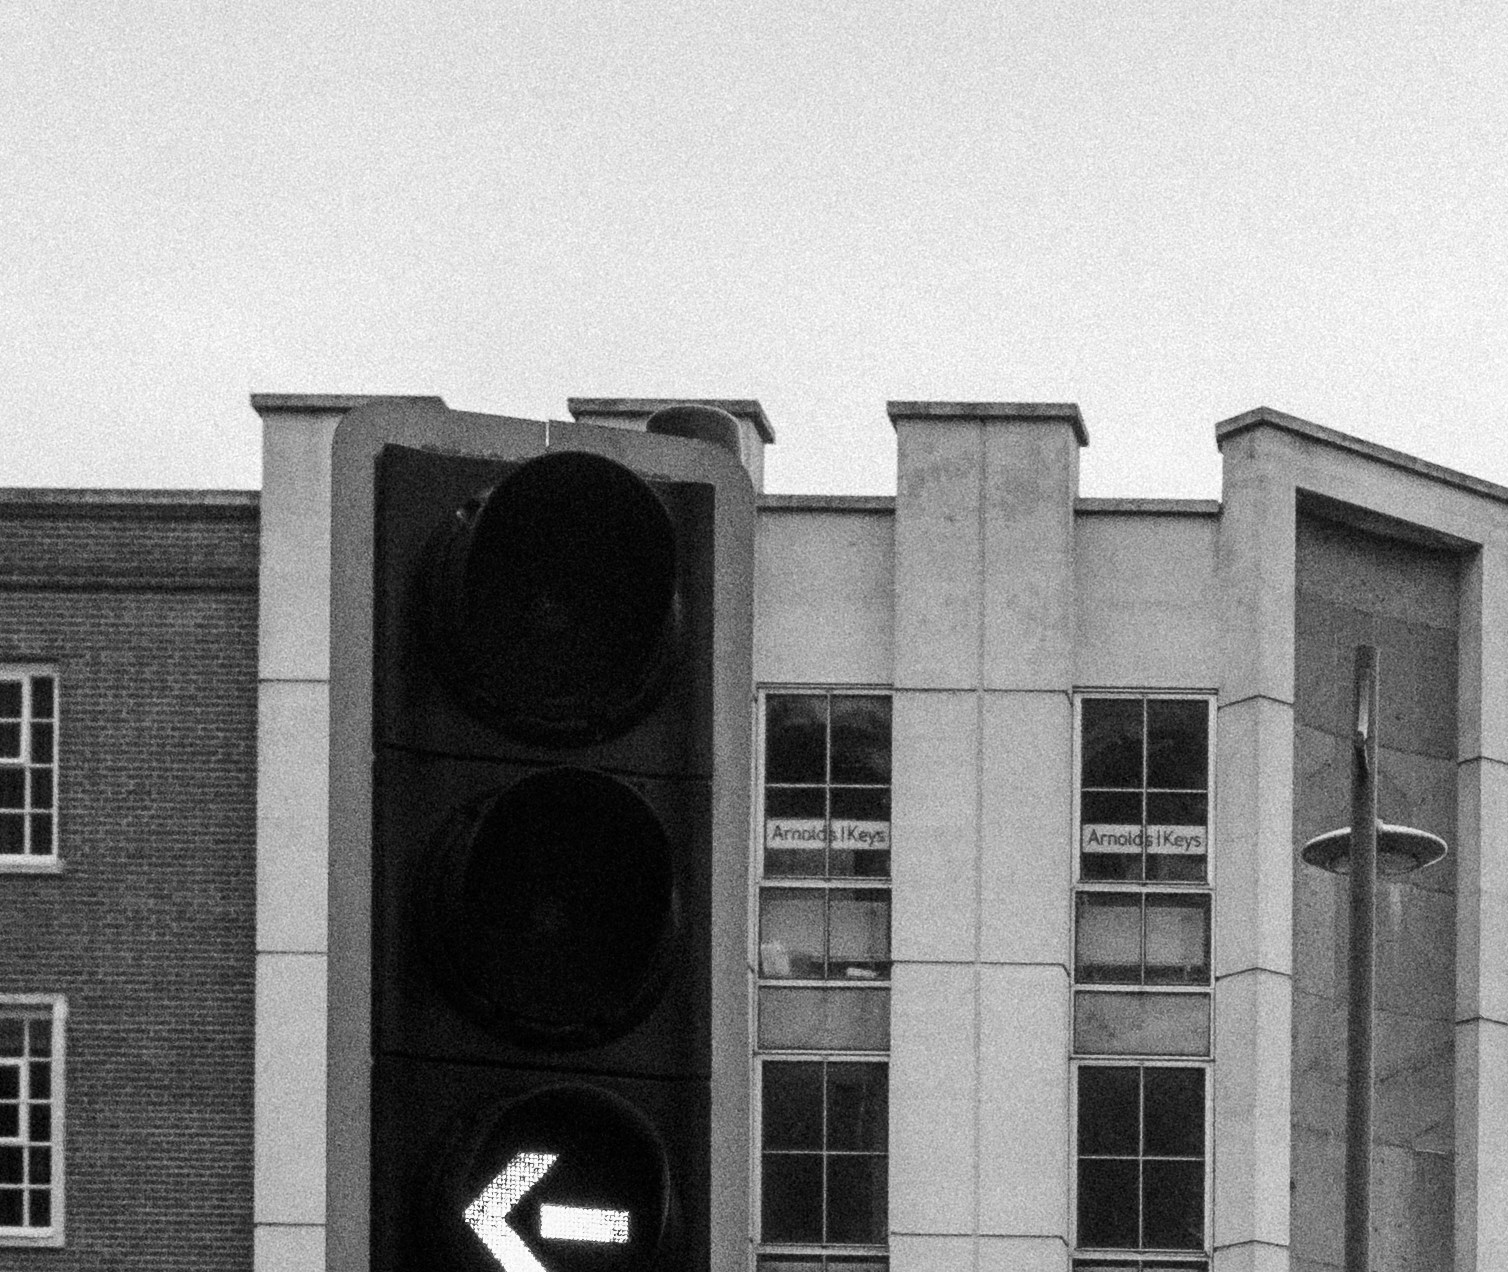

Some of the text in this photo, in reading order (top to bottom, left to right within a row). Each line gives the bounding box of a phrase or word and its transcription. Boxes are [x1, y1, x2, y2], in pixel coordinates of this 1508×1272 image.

[772, 825, 886, 848] Arnolds Keys
[1087, 829, 1202, 852] Arnolds Keys
